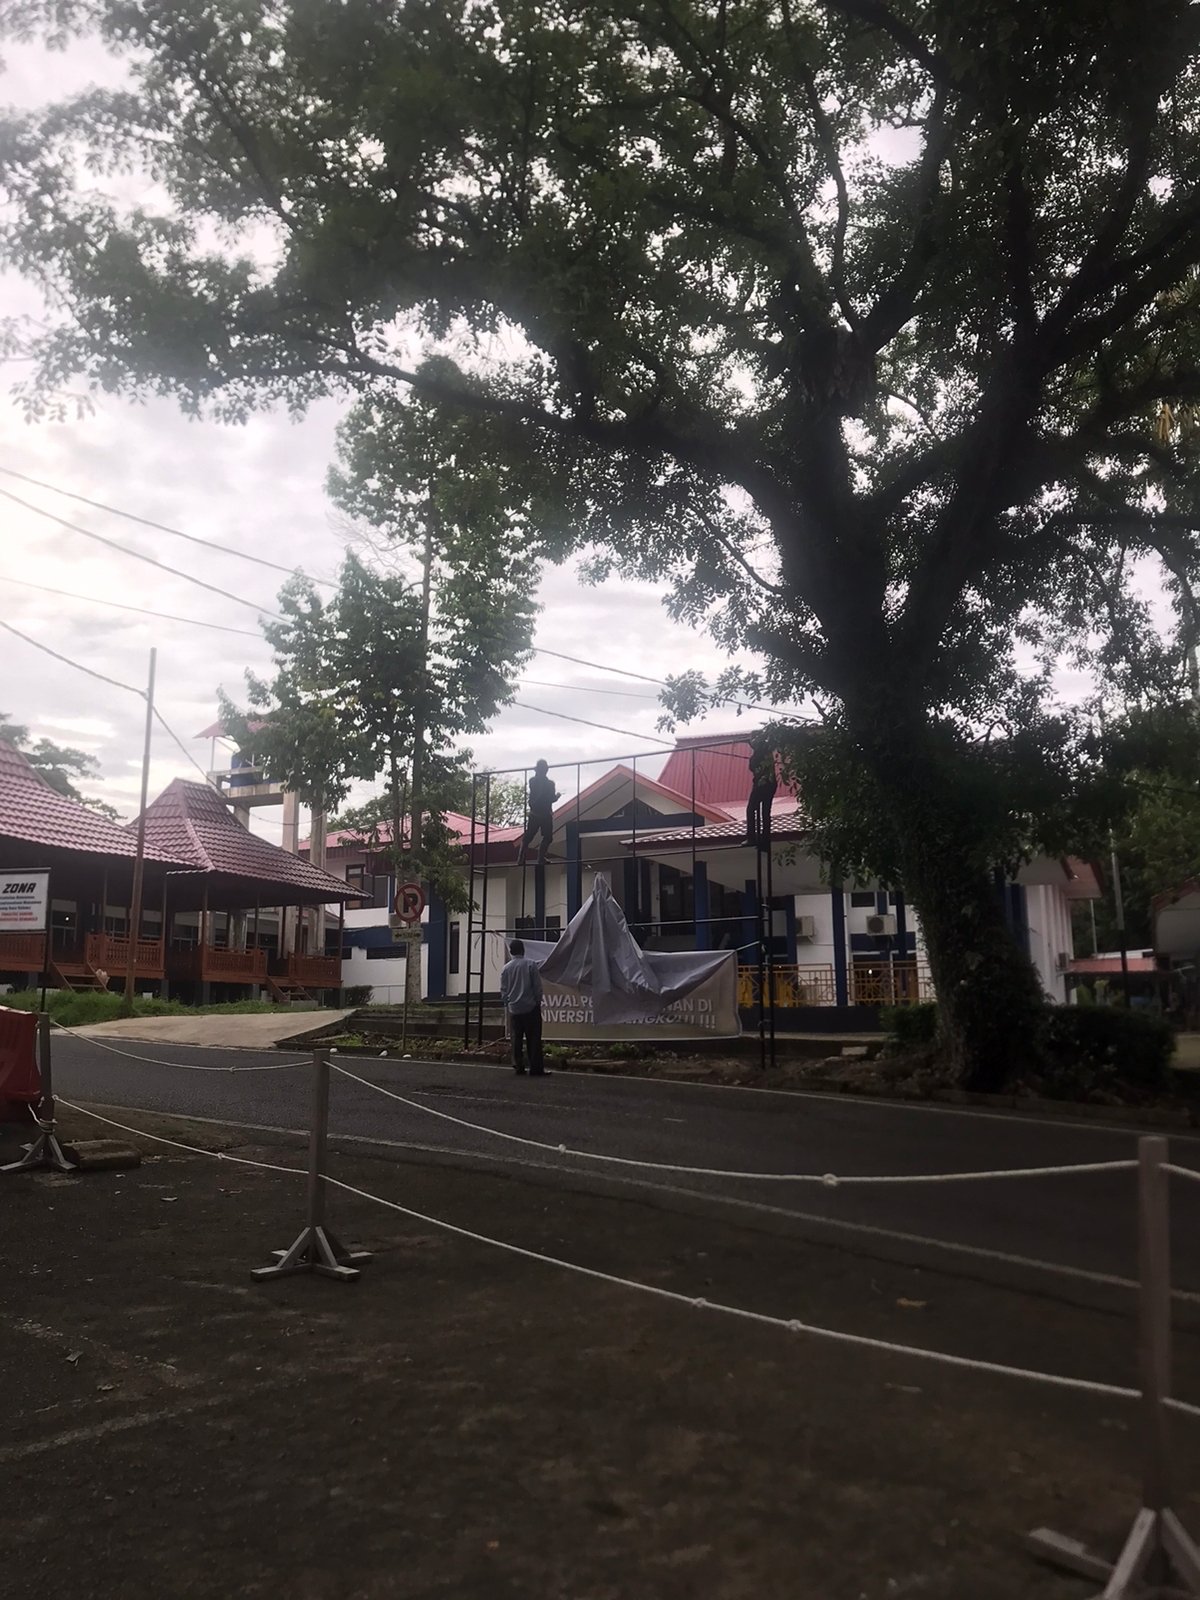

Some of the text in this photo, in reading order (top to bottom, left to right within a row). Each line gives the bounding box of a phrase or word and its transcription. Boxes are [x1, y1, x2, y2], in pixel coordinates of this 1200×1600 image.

[2, 882, 37, 894] ZONA
[698, 999, 712, 1012] DI
[541, 1010, 594, 1023] NIVERSIT
